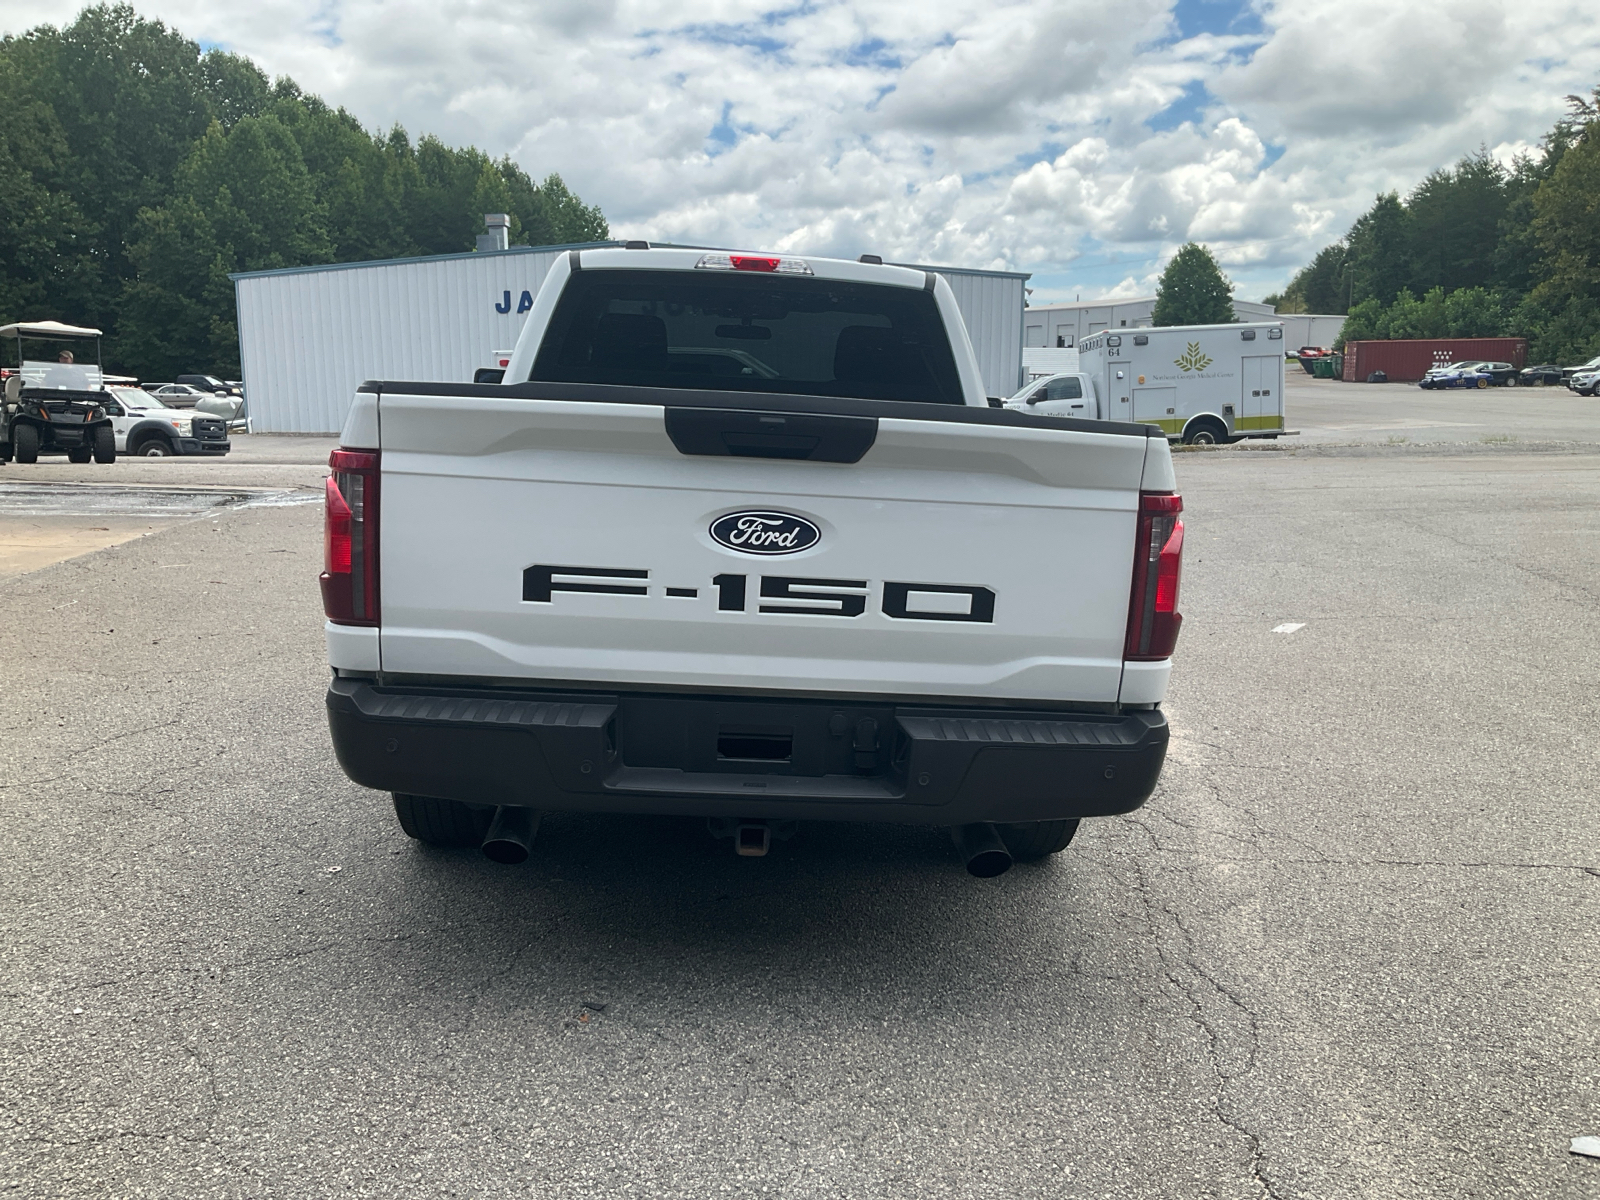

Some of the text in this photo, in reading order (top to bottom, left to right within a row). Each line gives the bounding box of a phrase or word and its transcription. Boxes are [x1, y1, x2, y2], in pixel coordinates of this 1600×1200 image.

[1108, 348, 1120, 357] 64
[1432, 361, 1452, 370] ZIM
[729, 516, 800, 548] Ford
[522, 564, 996, 623] F-150
